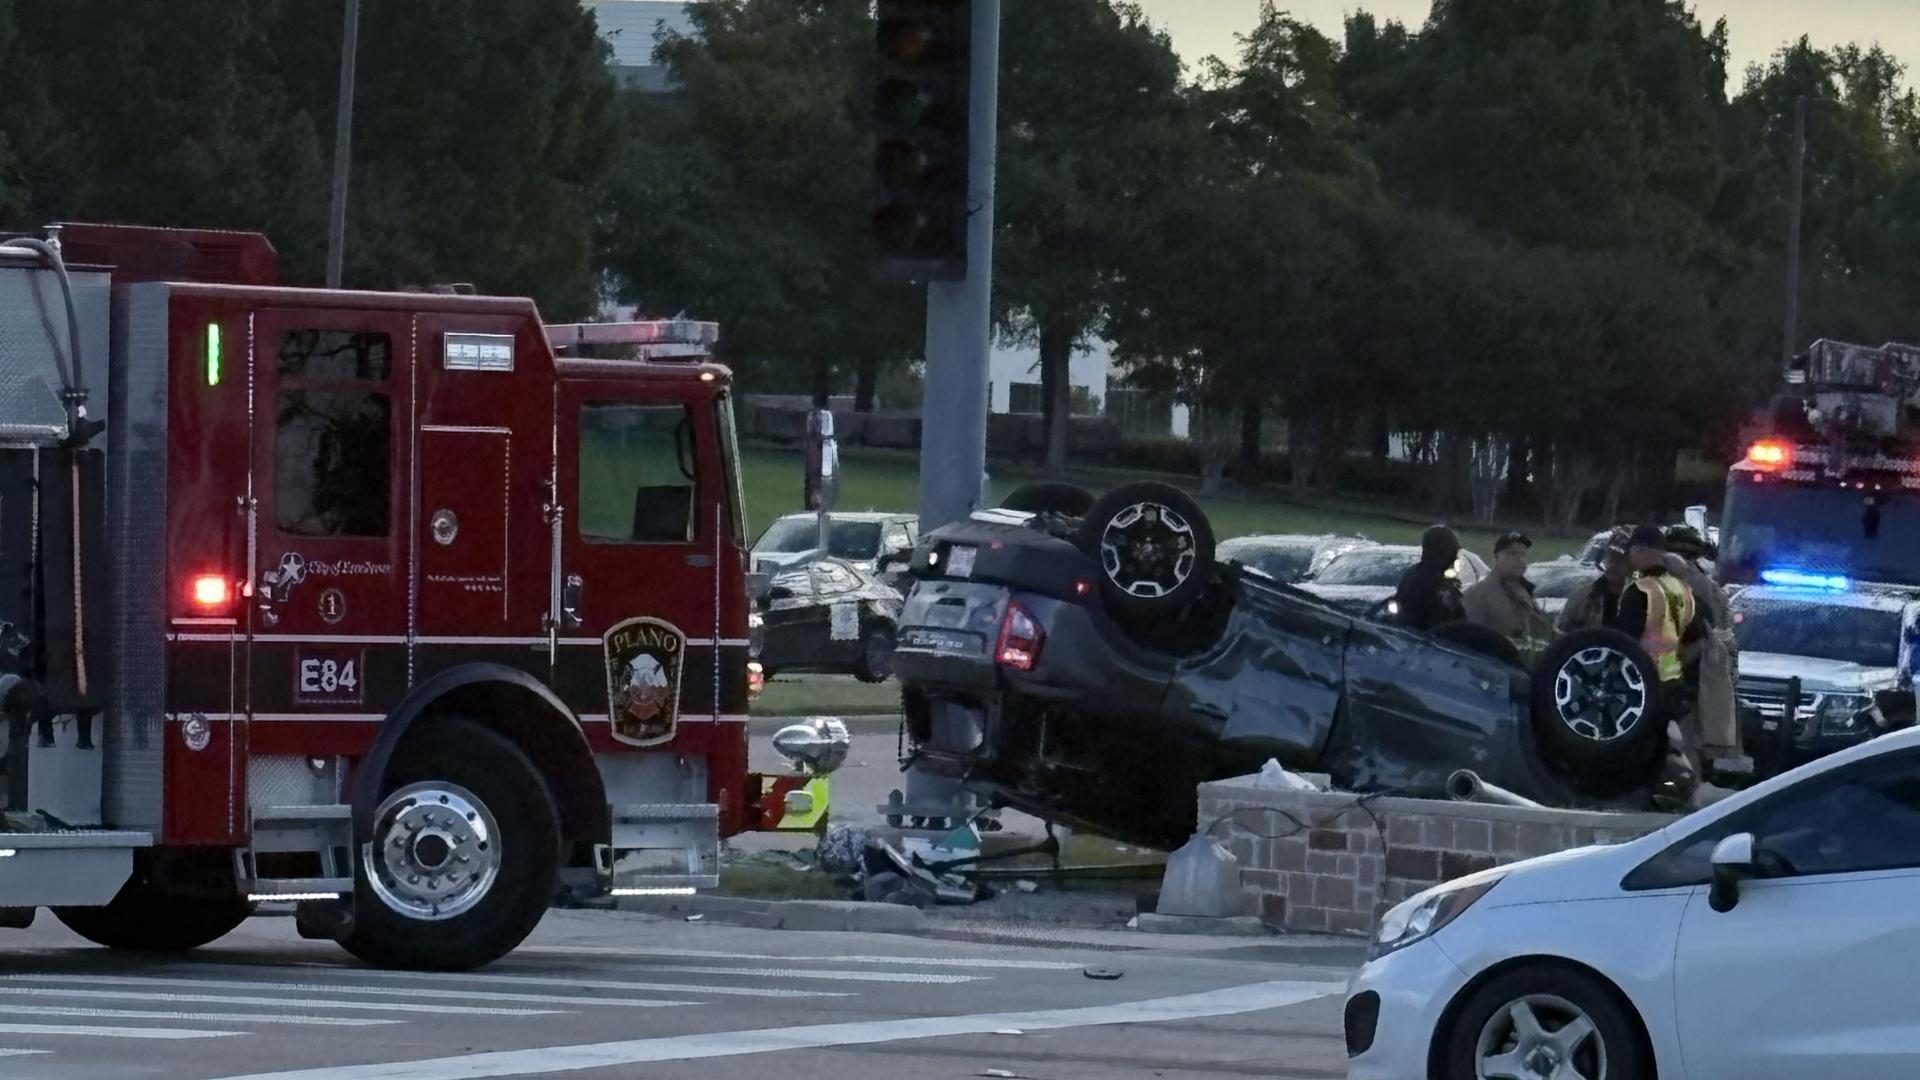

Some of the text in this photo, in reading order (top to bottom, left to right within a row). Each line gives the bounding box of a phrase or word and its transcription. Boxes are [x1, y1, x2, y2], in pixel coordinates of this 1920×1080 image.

[327, 594, 337, 616] 1
[614, 627, 677, 653] PLANO
[300, 658, 357, 693] E84
